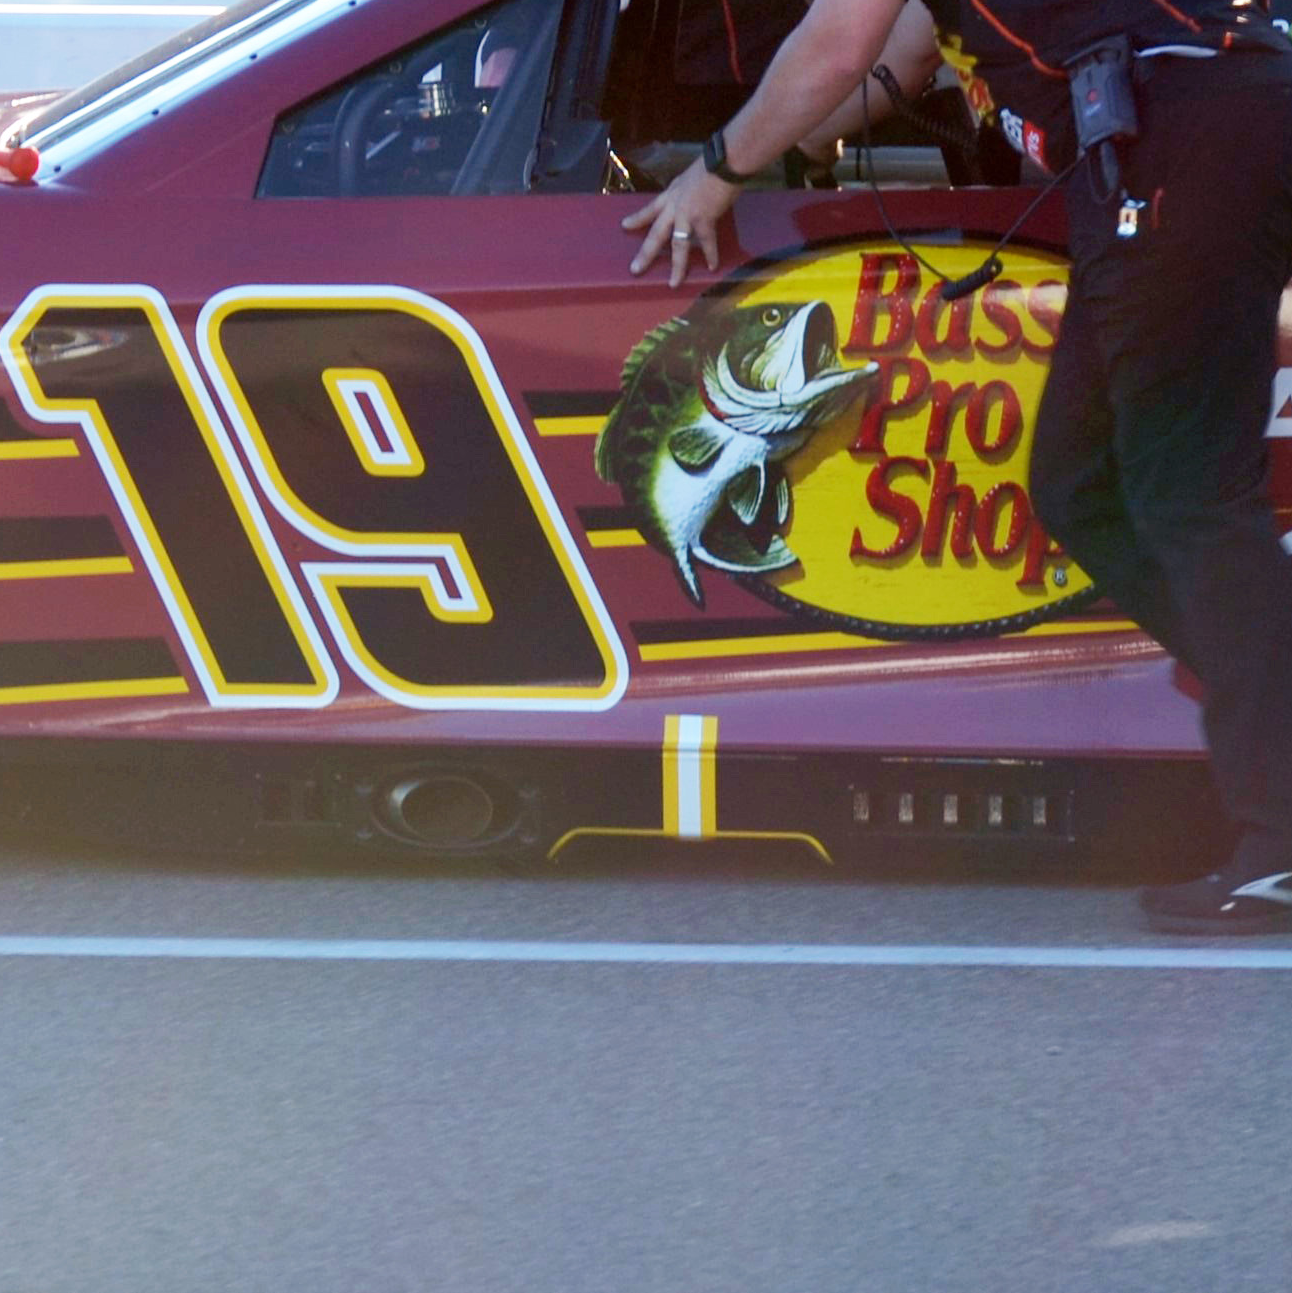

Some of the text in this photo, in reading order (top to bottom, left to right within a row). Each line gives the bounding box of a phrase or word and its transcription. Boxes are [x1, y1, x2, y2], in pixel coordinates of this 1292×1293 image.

[840, 252, 1068, 356] Bass
[848, 358, 1024, 456] Pro
[849, 456, 1064, 587] Shop
